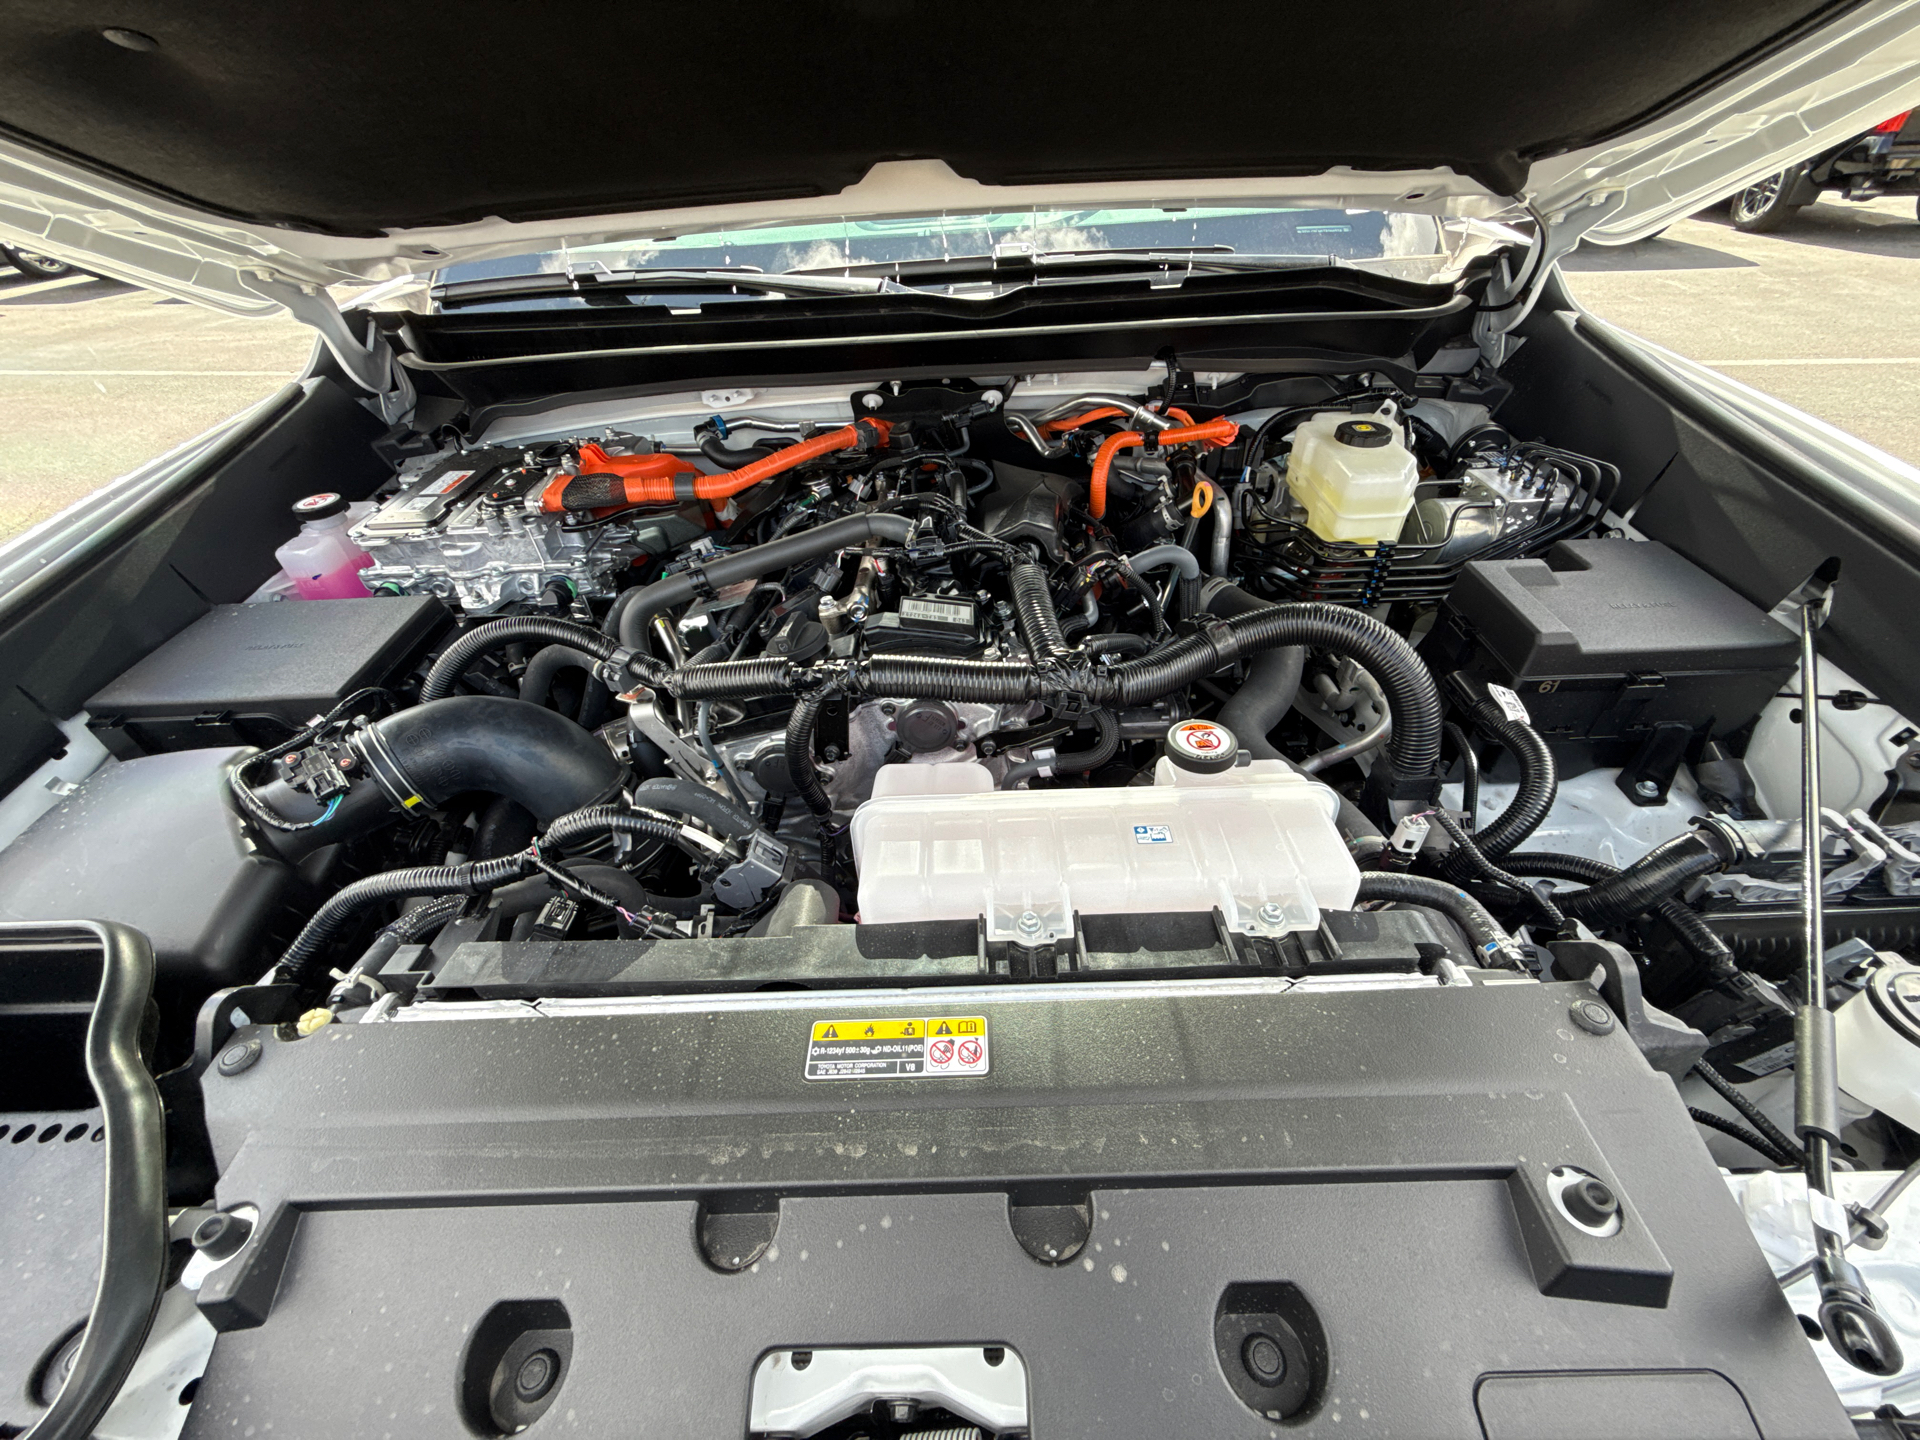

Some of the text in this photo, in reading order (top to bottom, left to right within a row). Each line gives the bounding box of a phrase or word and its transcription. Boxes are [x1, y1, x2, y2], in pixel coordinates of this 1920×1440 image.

[1539, 680, 1561, 694] 61
[820, 1047, 845, 1056] R-1234yf
[905, 1063, 916, 1072] V8
